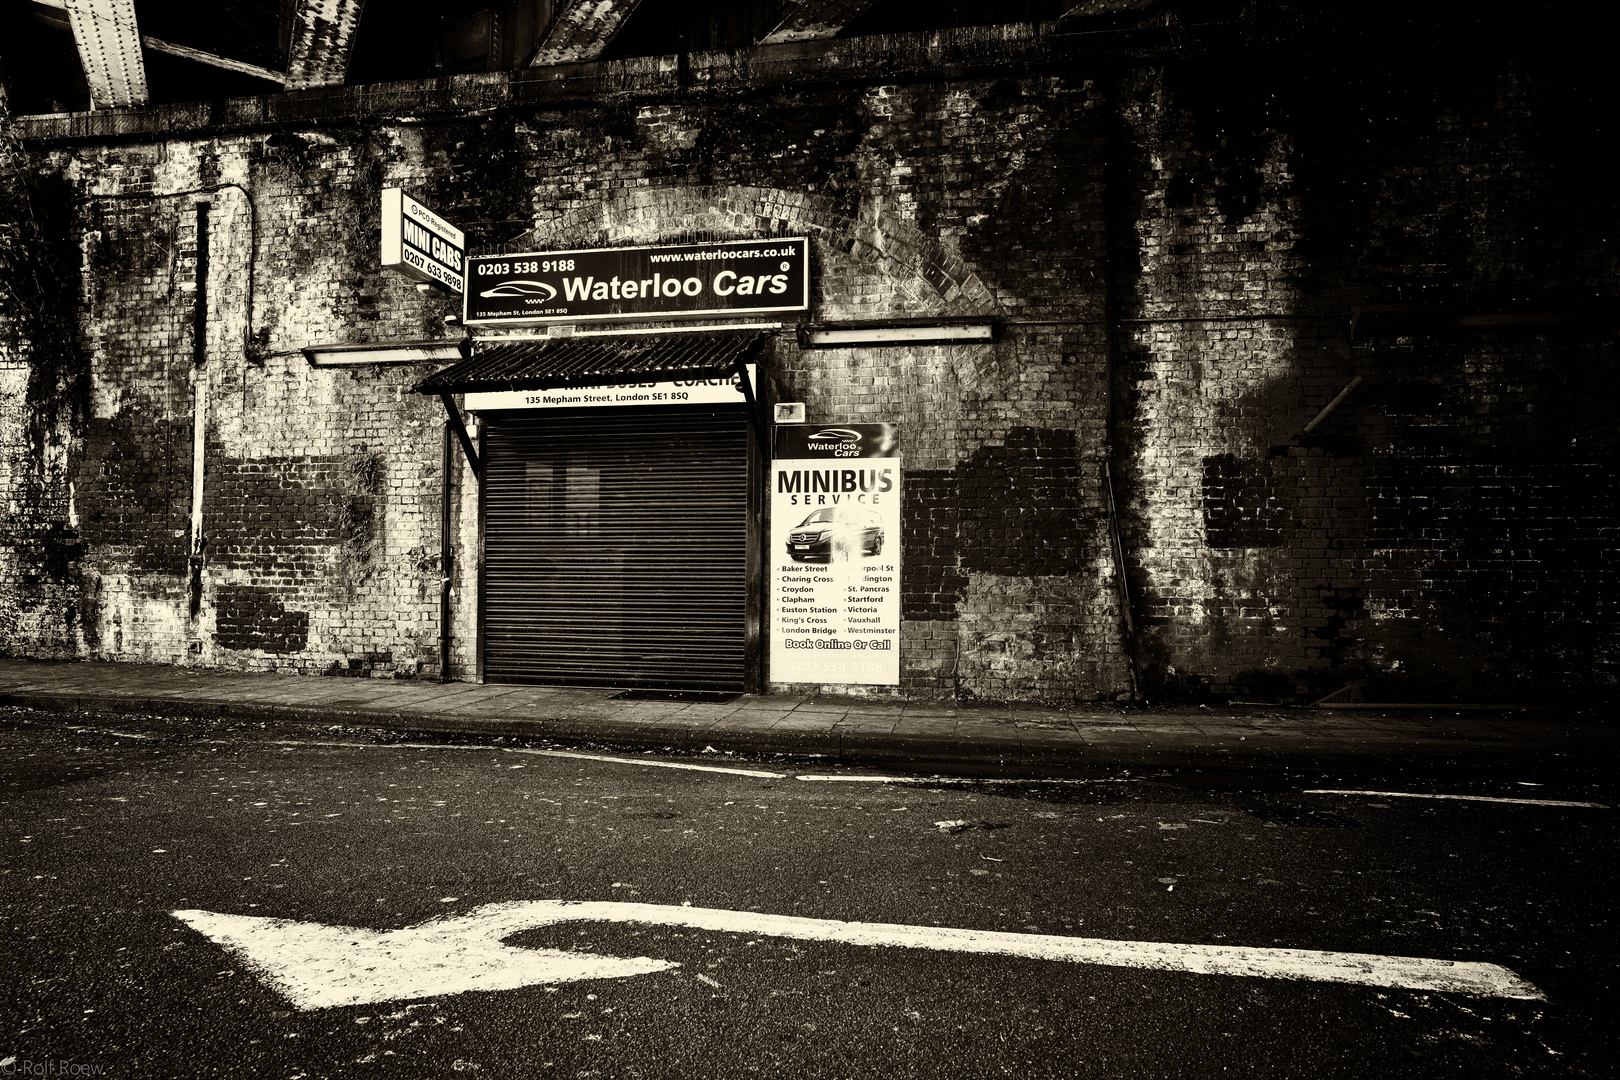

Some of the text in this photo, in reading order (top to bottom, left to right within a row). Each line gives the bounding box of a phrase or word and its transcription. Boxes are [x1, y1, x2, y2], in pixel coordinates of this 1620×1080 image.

[419, 210, 456, 239] PCO Registered
[404, 217, 461, 271] MINI CABS
[650, 246, 795, 262] www.waterloocars.co.uk
[404, 249, 461, 289] 0207 633 9898
[478, 260, 575, 275] 0203 538 9188
[562, 271, 788, 301] Waterloo Cars
[526, 396, 540, 404] 135
[543, 396, 580, 404] Mepham
[615, 393, 649, 401] London
[671, 392, 689, 400] 8SQ
[778, 469, 893, 493] MINIBUS
[782, 586, 814, 594] Croydon
[782, 596, 815, 604] Clapham
[812, 627, 837, 635] Bridge
[785, 639, 891, 650] Book Online Or Call
